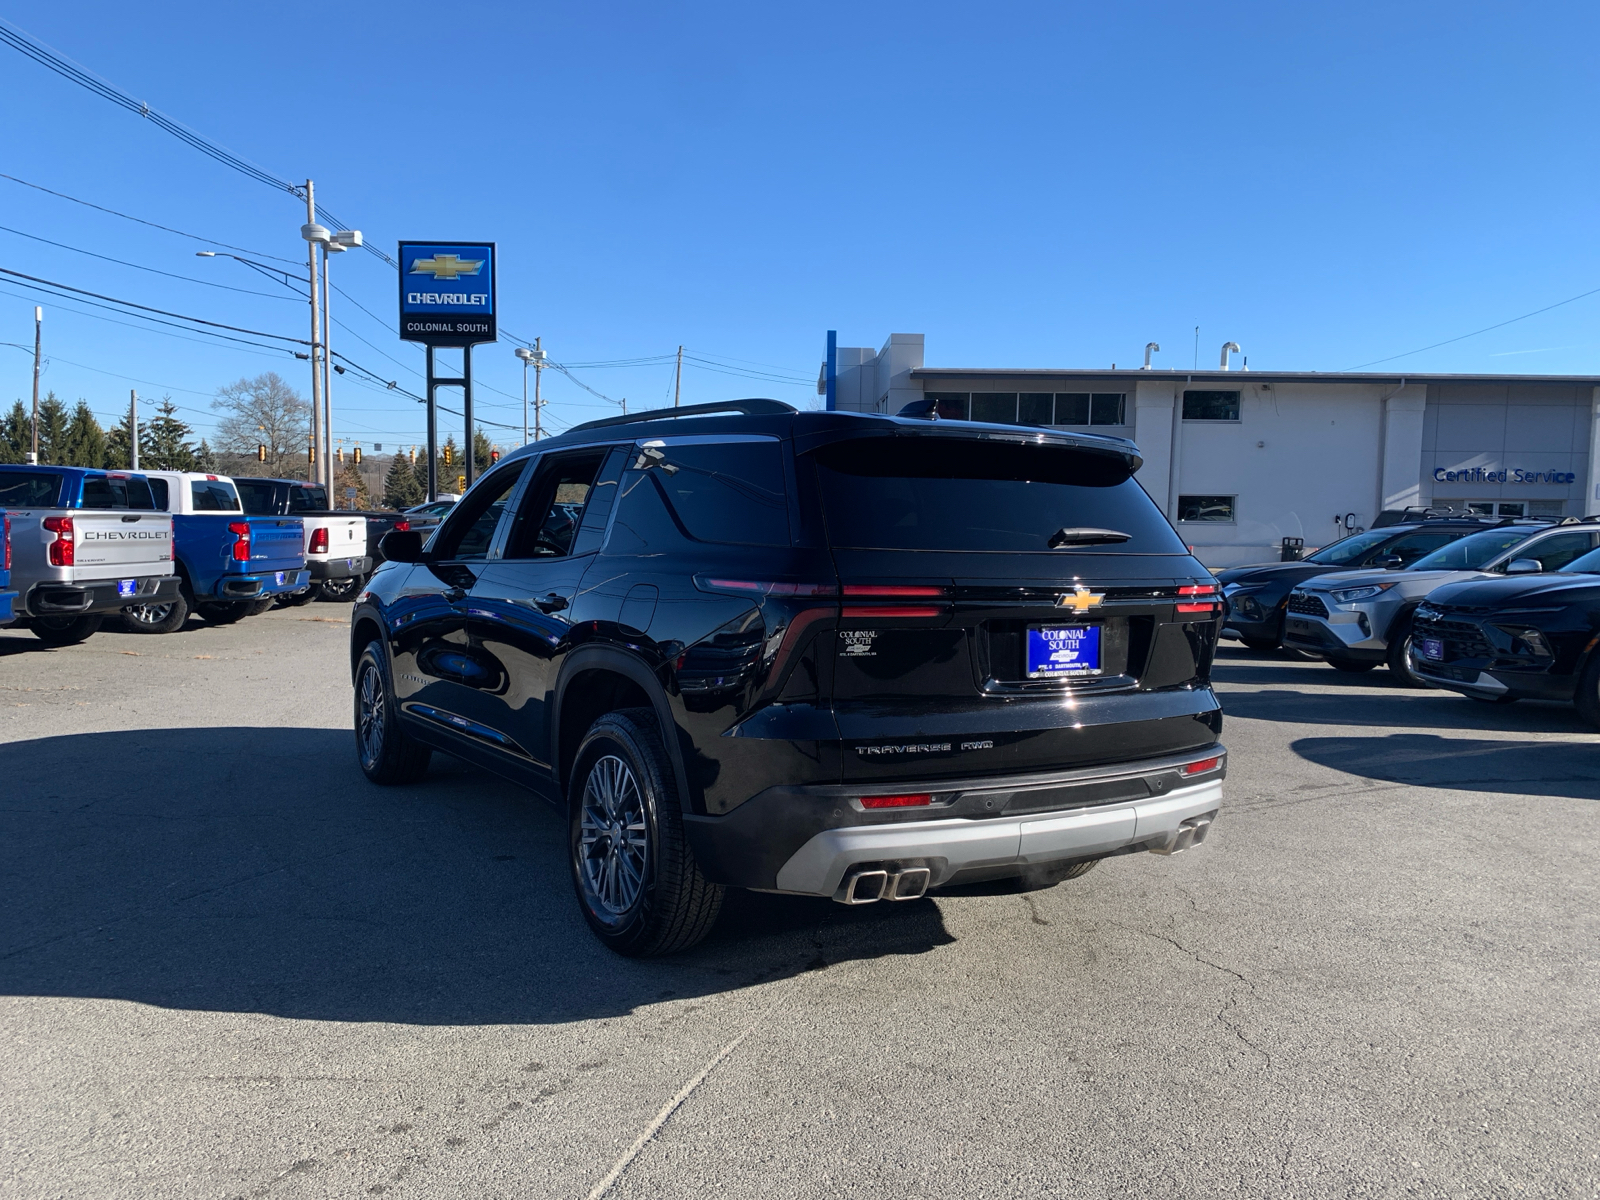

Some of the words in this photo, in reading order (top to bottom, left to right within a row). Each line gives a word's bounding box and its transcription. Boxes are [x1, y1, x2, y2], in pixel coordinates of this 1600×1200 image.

[407, 292, 488, 305] CHEVROLET
[407, 322, 454, 332] COLONIAL
[456, 323, 488, 333] SOUTH
[1433, 467, 1508, 483] Certified
[1512, 468, 1576, 484] Service
[84, 531, 169, 540] CHEVROLET
[1042, 630, 1086, 640] COLONIAL
[1049, 640, 1079, 650] SOUTH
[855, 743, 952, 755] TRAVERSE
